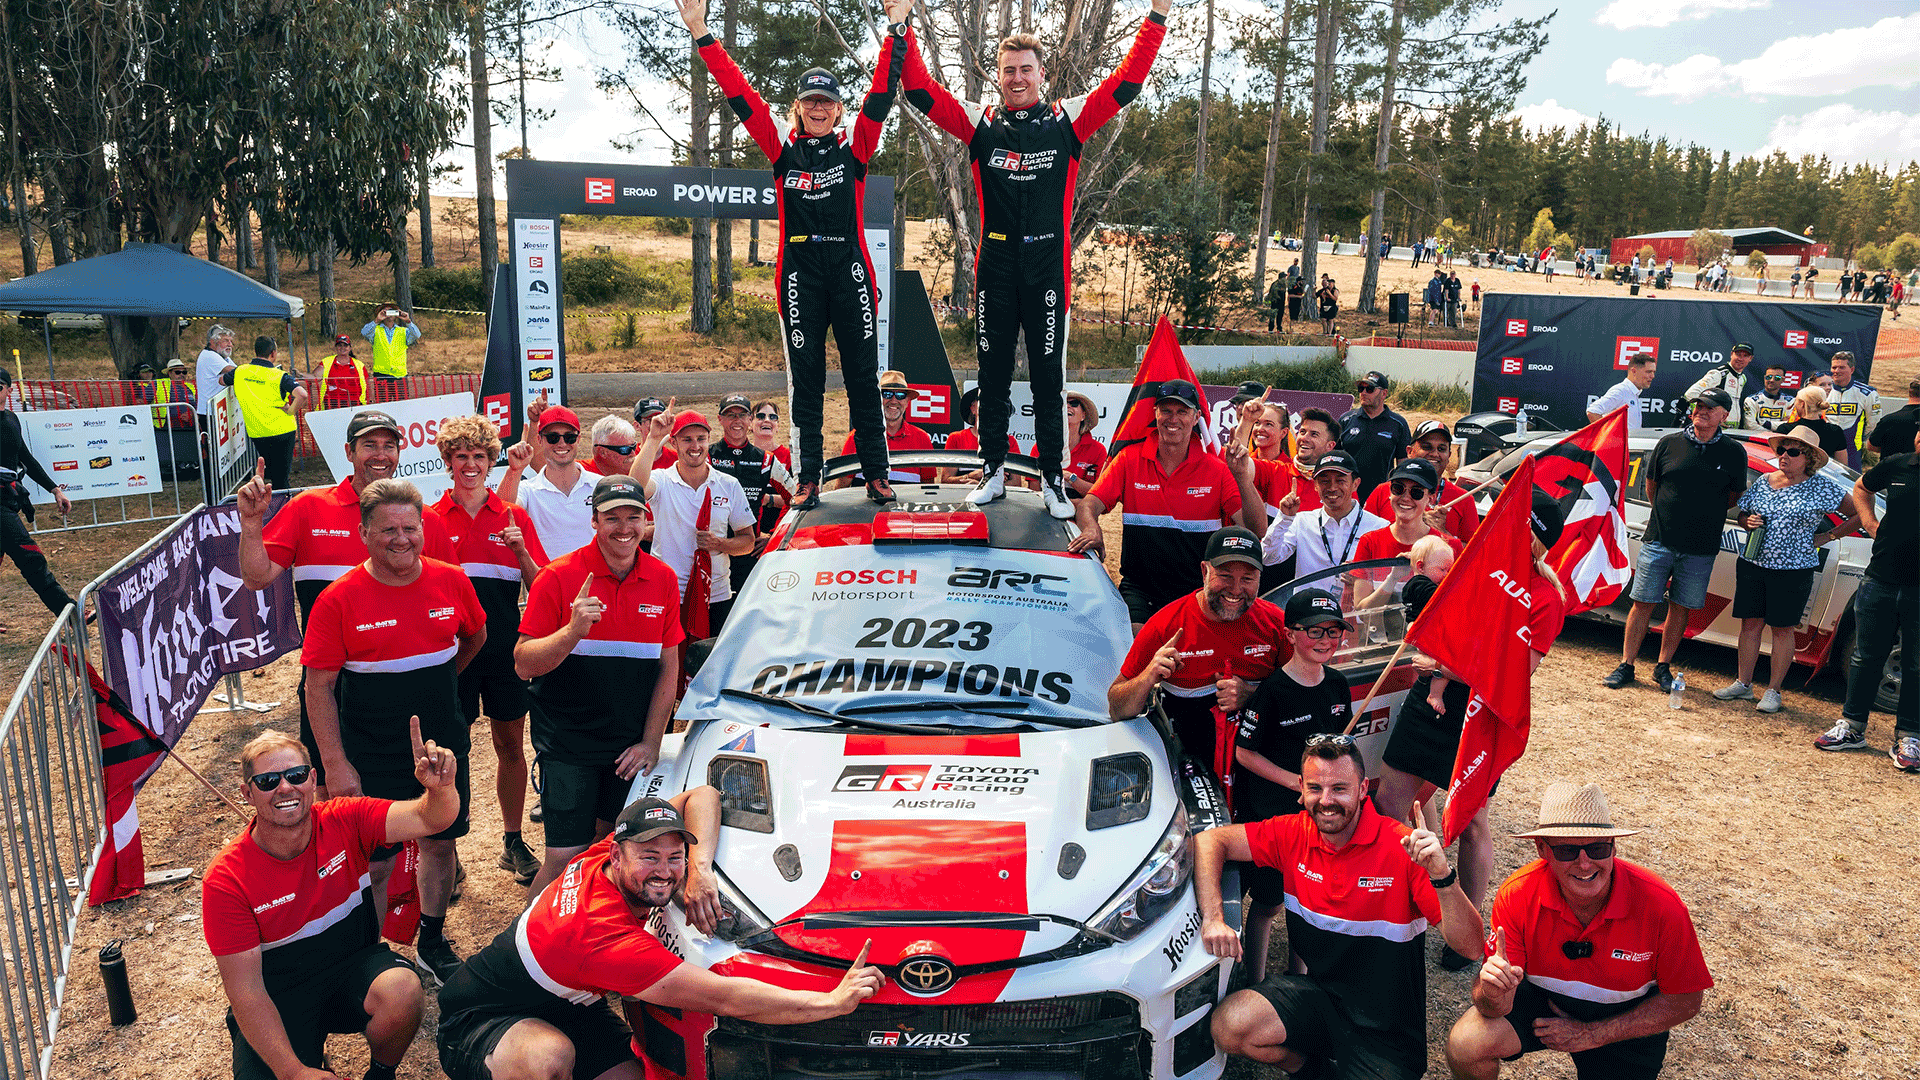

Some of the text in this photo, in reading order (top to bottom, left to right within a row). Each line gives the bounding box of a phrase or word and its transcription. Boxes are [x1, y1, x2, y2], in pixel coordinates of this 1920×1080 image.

[1021, 155, 1054, 166] GAZOO
[1023, 149, 1058, 160] TOYOTA
[988, 155, 1020, 171] GR
[1020, 161, 1053, 171] Racing
[813, 170, 844, 184] GAZOO
[814, 163, 845, 178] TOYOTA
[1007, 173, 1037, 181] Australia
[785, 174, 812, 190] GR
[622, 186, 658, 198] EROAD
[673, 183, 757, 205] POWER
[802, 191, 831, 200] Australia
[788, 271, 800, 326] TOYOTA
[857, 284, 874, 340] TOYOTA
[978, 290, 986, 333] TOYOTA
[1044, 309, 1056, 355] TOYOTA
[1532, 325, 1558, 333] EROAD
[1813, 337, 1842, 345] EROAD
[1670, 350, 1723, 363] EROAD
[1528, 363, 1553, 371] EROAD
[1523, 403, 1549, 411] EROAD
[392, 457, 447, 480] otorspo
[117, 550, 169, 614] WELCOME
[199, 510, 243, 541] AN
[814, 569, 918, 586] BOSCH
[811, 588, 915, 603] Motorsport
[947, 591, 1069, 608] MOTORSPORT AUSTRALIA
[983, 598, 1069, 612] CHAMPIONSHIP
[854, 617, 994, 651] 2023
[751, 657, 1073, 705] CHAMPIONS
[940, 764, 1040, 776] TOYOTA
[834, 772, 925, 791] GR
[935, 773, 1029, 784] GAZOO
[931, 782, 1025, 796] Racing
[892, 798, 976, 810] Australia
[1162, 905, 1203, 973] Hoosie
[868, 1034, 899, 1046] GR
